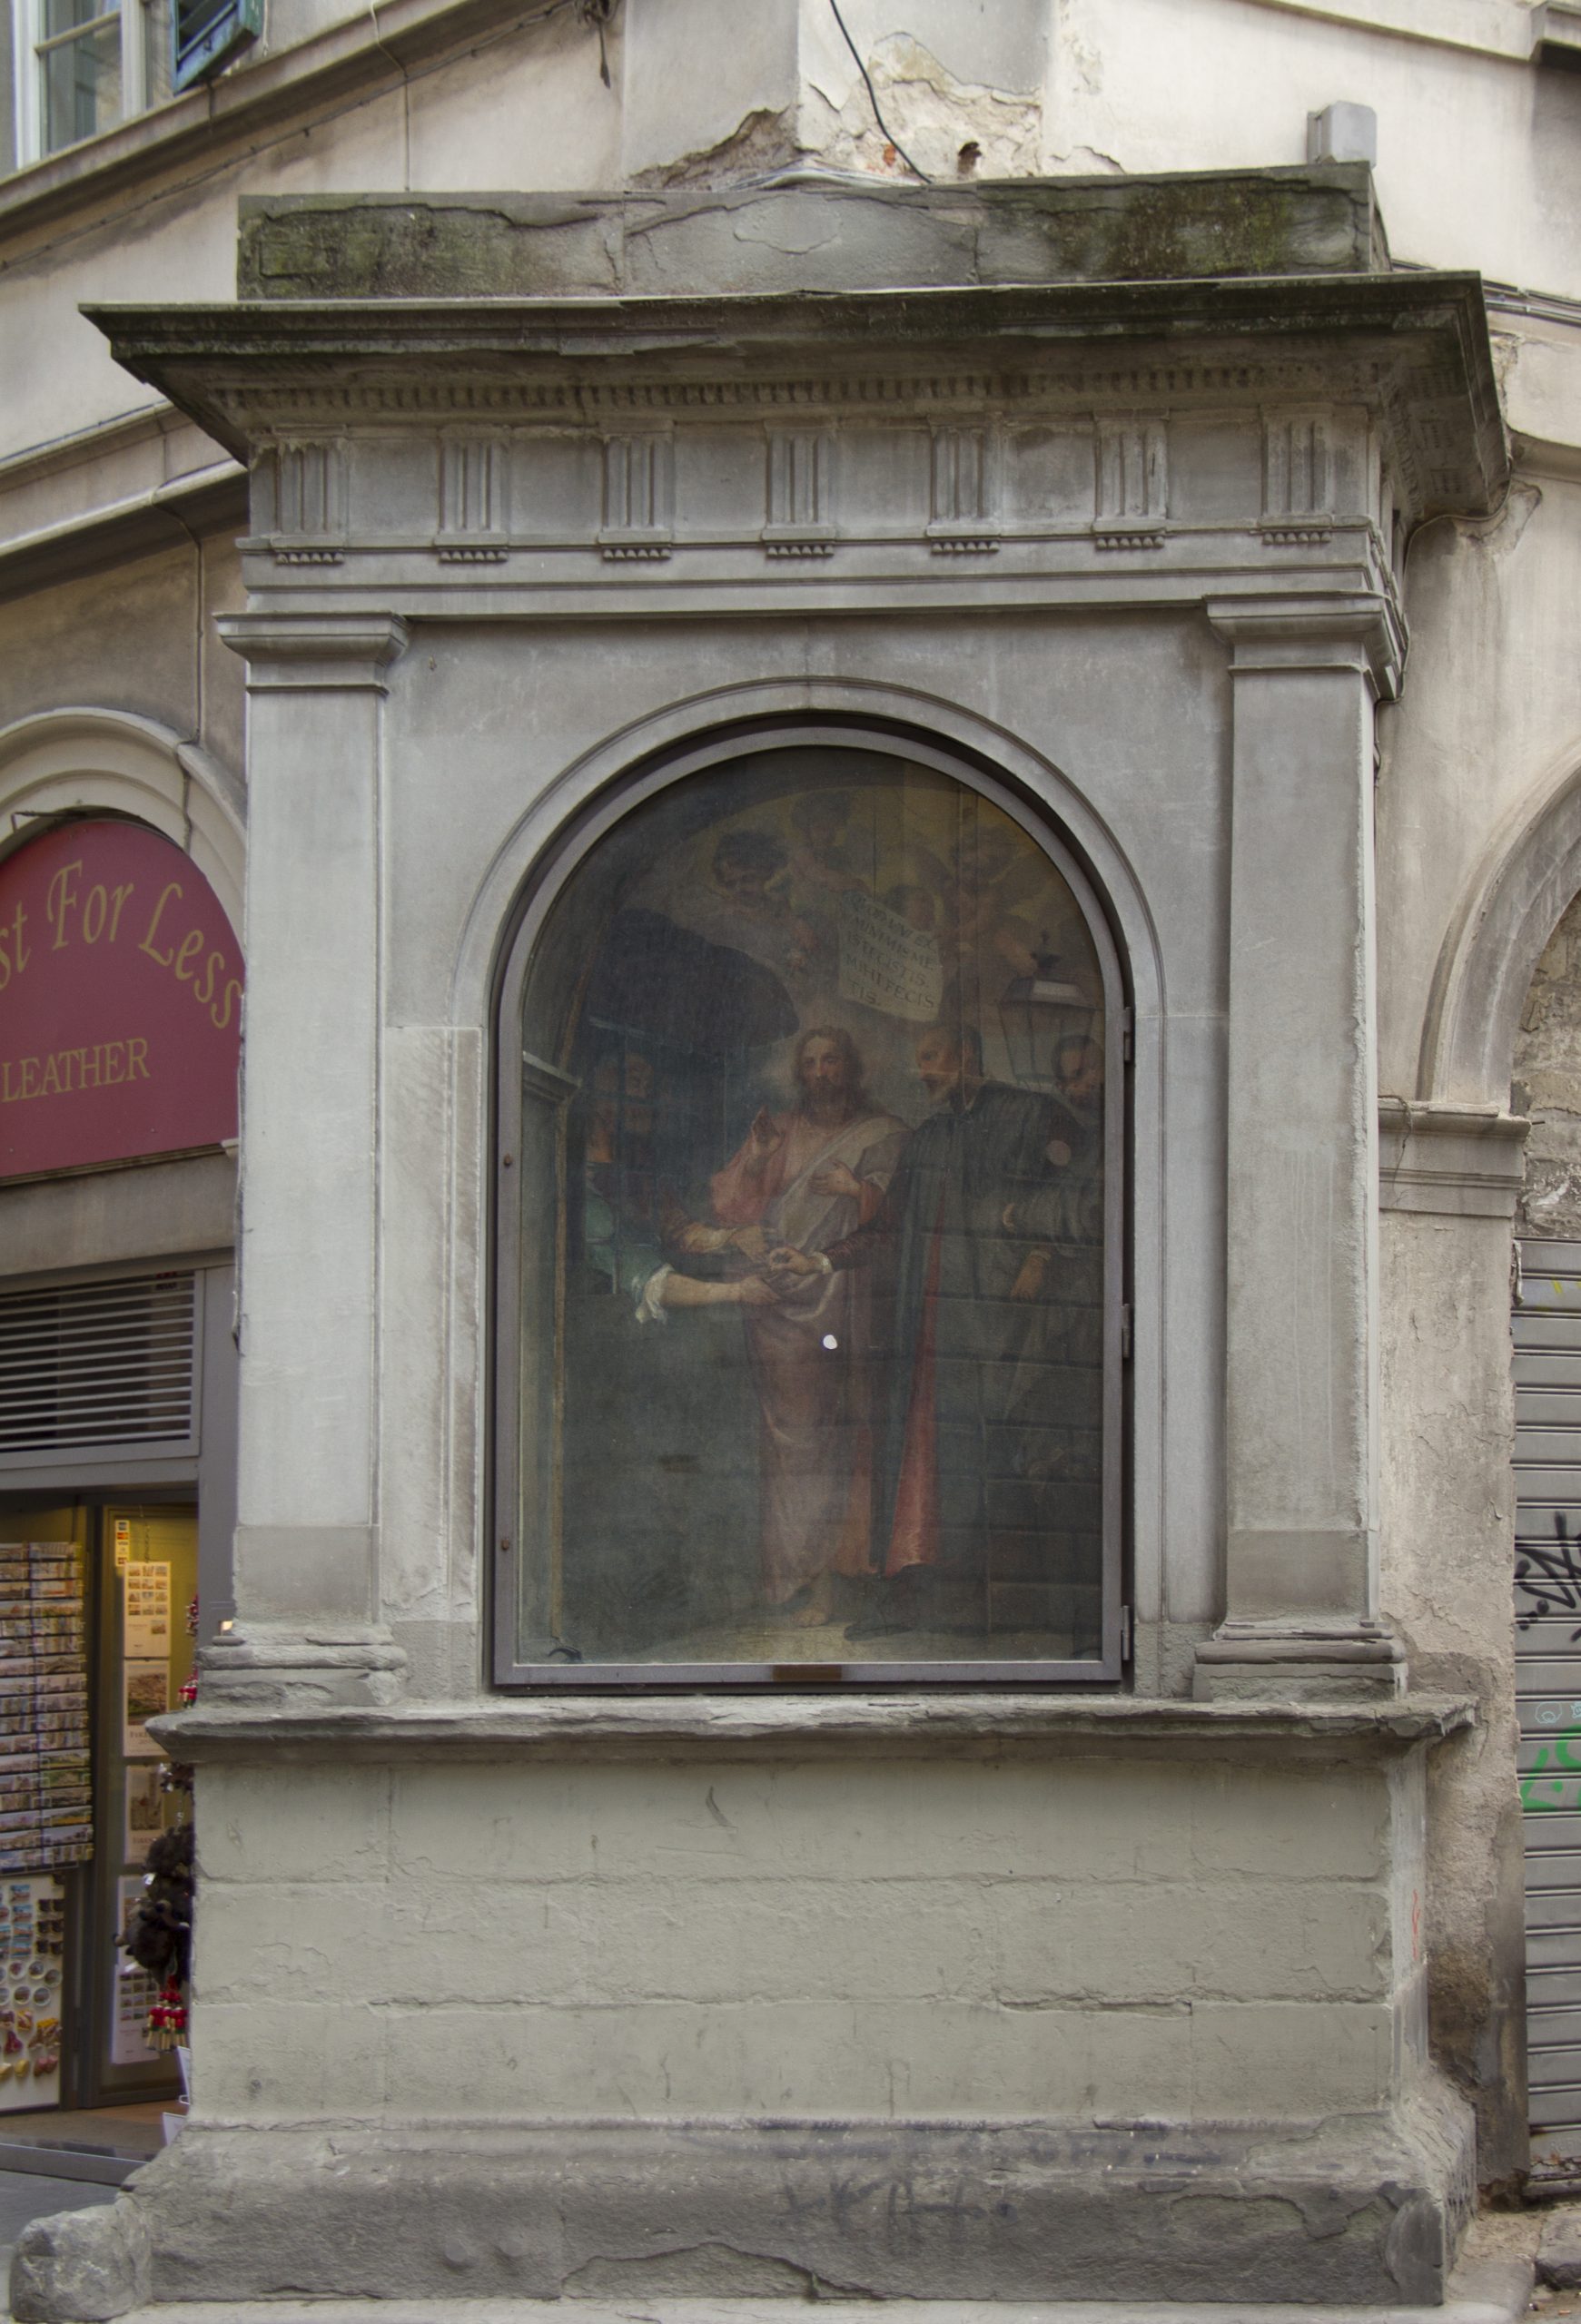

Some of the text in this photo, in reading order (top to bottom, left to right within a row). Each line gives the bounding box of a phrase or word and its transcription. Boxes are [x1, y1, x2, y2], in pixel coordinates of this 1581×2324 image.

[47, 859, 134, 950] For
[139, 882, 242, 1029] Less
[884, 979, 934, 1009] FECIS
[2, 1038, 151, 1103] LEATHER
